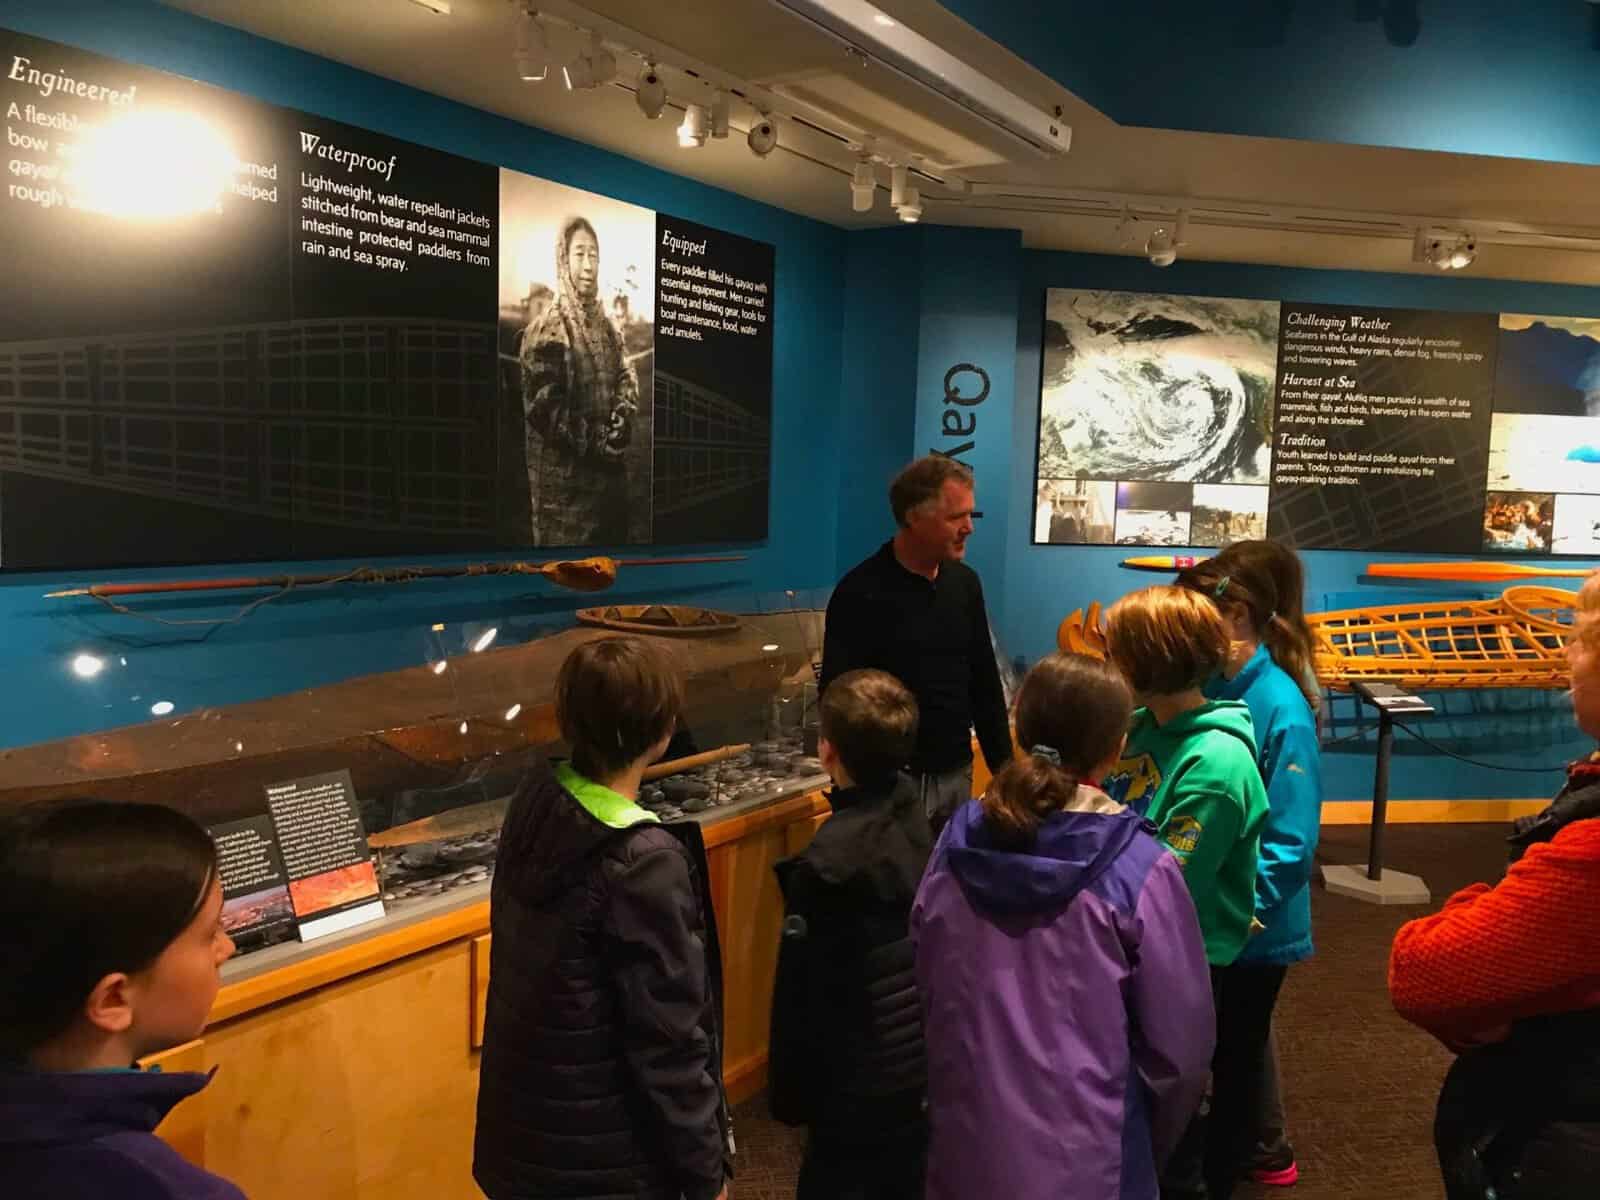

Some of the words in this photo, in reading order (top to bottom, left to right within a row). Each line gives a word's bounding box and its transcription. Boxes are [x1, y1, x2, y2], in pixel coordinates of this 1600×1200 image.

[8, 56, 136, 104] Engineered
[8, 102, 22, 120] A
[24, 104, 82, 130] flexibl
[8, 127, 48, 151] bow
[300, 131, 397, 181] Waterproof
[301, 171, 375, 204] Lightweight,
[377, 193, 409, 210] water
[411, 200, 455, 220] repellant
[457, 209, 490, 228] jackets
[301, 195, 349, 217] stitched
[350, 205, 379, 224] from
[380, 210, 404, 229] bear
[406, 220, 426, 235] and
[427, 224, 445, 239] sea
[447, 228, 490, 248] mammal
[301, 216, 353, 239] intestine
[359, 230, 413, 251] protected
[418, 242, 462, 261] paddlers
[466, 250, 490, 267] from
[662, 229, 707, 256] Equipped
[301, 240, 325, 256] rain
[328, 245, 351, 260] and
[353, 251, 373, 264] sea
[375, 254, 409, 272] spray.
[661, 258, 681, 275] Every
[682, 265, 707, 279] paddler
[707, 269, 724, 283] filled
[724, 273, 734, 286] his
[754, 283, 768, 293] with
[660, 277, 691, 291] essential
[691, 284, 729, 300] equipment.
[729, 290, 743, 303] Men
[743, 295, 764, 308] carried
[660, 290, 687, 309] hunting
[688, 298, 702, 309] and
[702, 299, 724, 317] fishing
[724, 307, 741, 319] gear,
[741, 308, 757, 320] tools
[757, 311, 766, 322] for
[660, 306, 677, 320] boat
[722, 319, 739, 334] food,
[660, 324, 675, 336] and
[1287, 313, 1346, 331] Challenging
[1351, 316, 1391, 330] Weather
[1320, 332, 1327, 340] in
[1328, 332, 1341, 341] the
[1342, 333, 1357, 342] Gulf
[1358, 334, 1367, 343] of
[1367, 334, 1391, 344] Alaska
[1392, 336, 1424, 347] regularly
[1283, 354, 1298, 363] and
[1299, 355, 1332, 367] towering
[1333, 358, 1358, 367] waves.
[1284, 341, 1323, 353] dangerous
[1324, 344, 1348, 354] winds,
[1350, 345, 1372, 356] heavy
[1394, 347, 1416, 357] dense
[1417, 349, 1432, 360] fog,
[1463, 352, 1484, 363] spray
[1283, 373, 1322, 386] Harvest
[1324, 377, 1335, 388] at
[1337, 375, 1356, 388] Sea
[1280, 389, 1301, 399] From
[1302, 390, 1320, 400] their
[1368, 395, 1386, 403] men
[1386, 395, 1416, 405] pursued
[1448, 397, 1457, 407] of
[1458, 399, 1470, 407] sea
[1280, 402, 1318, 412] mammals,
[1319, 402, 1333, 412] fish
[1334, 404, 1349, 413] and
[1349, 405, 1369, 415] birds,
[1370, 405, 1409, 418] harvesting
[1409, 408, 1417, 416] in
[1418, 407, 1430, 417] the
[1431, 410, 1450, 419] open
[1450, 410, 1472, 419] water
[1280, 413, 1294, 423] and
[1295, 414, 1316, 425] along
[1317, 415, 1329, 424] the
[1280, 432, 1327, 447] Tradition
[1277, 449, 1300, 459] Youth
[1300, 449, 1329, 460] learned
[1329, 452, 1337, 461] to
[1338, 452, 1357, 461] build
[1358, 453, 1372, 462] and
[1373, 453, 1397, 463] paddle
[1420, 455, 1438, 464] from
[1438, 455, 1455, 465] their
[1276, 463, 1306, 472] parents.
[1307, 463, 1333, 474] Today,
[1333, 464, 1369, 474] craftsmen
[1370, 467, 1382, 475] are
[1383, 466, 1421, 478] revitalizing
[1422, 467, 1435, 476] the
[1327, 476, 1360, 486] tradition.
